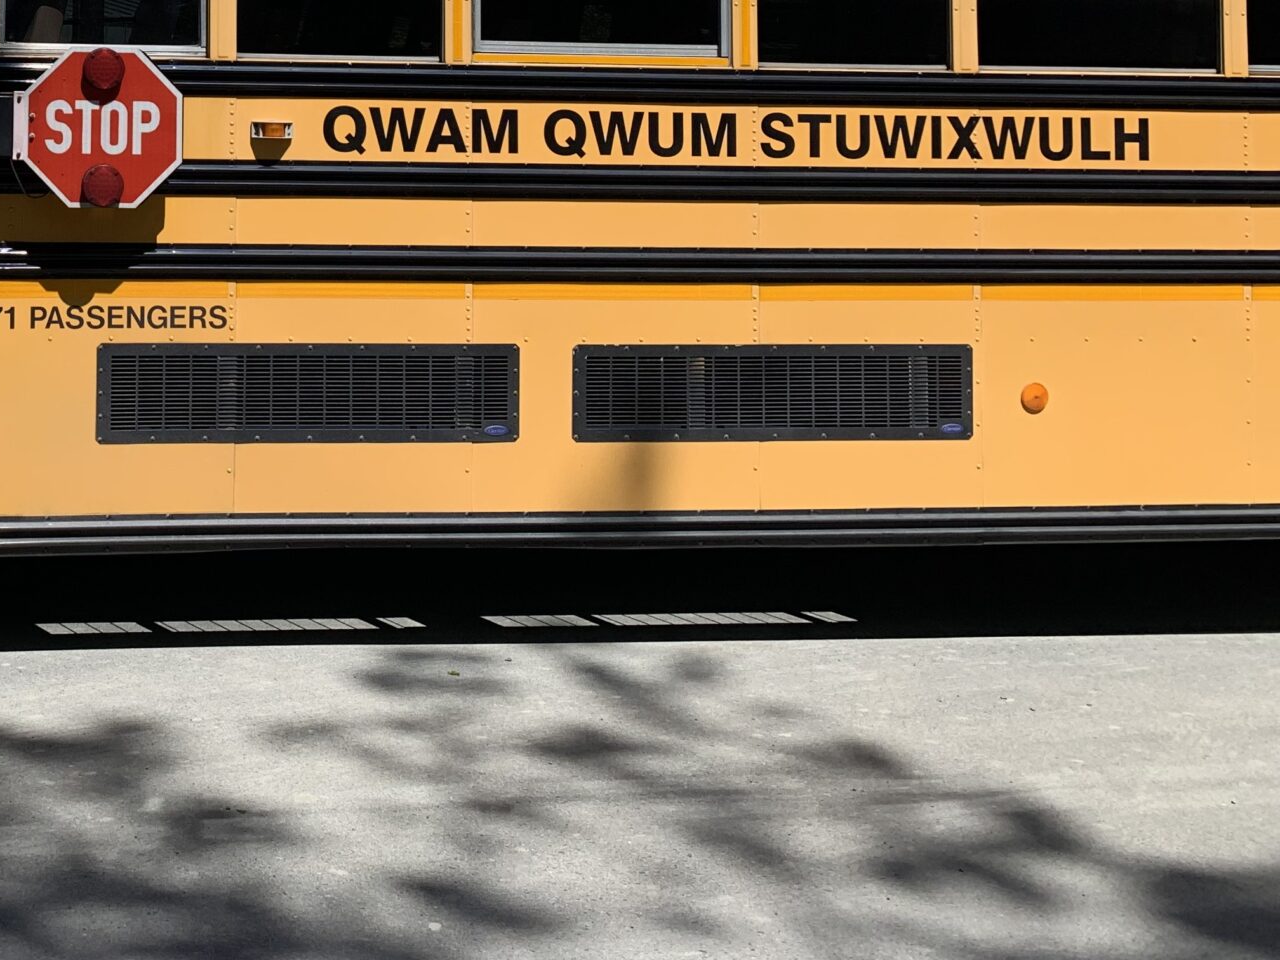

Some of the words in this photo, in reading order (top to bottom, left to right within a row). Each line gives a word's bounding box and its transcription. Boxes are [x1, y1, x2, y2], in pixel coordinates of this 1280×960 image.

[45, 99, 160, 155] STOP
[322, 105, 519, 155] QWAM
[543, 109, 738, 159] QWUM
[760, 112, 1150, 161] STUWIXWULH
[30, 305, 227, 330] PASSENGERS
